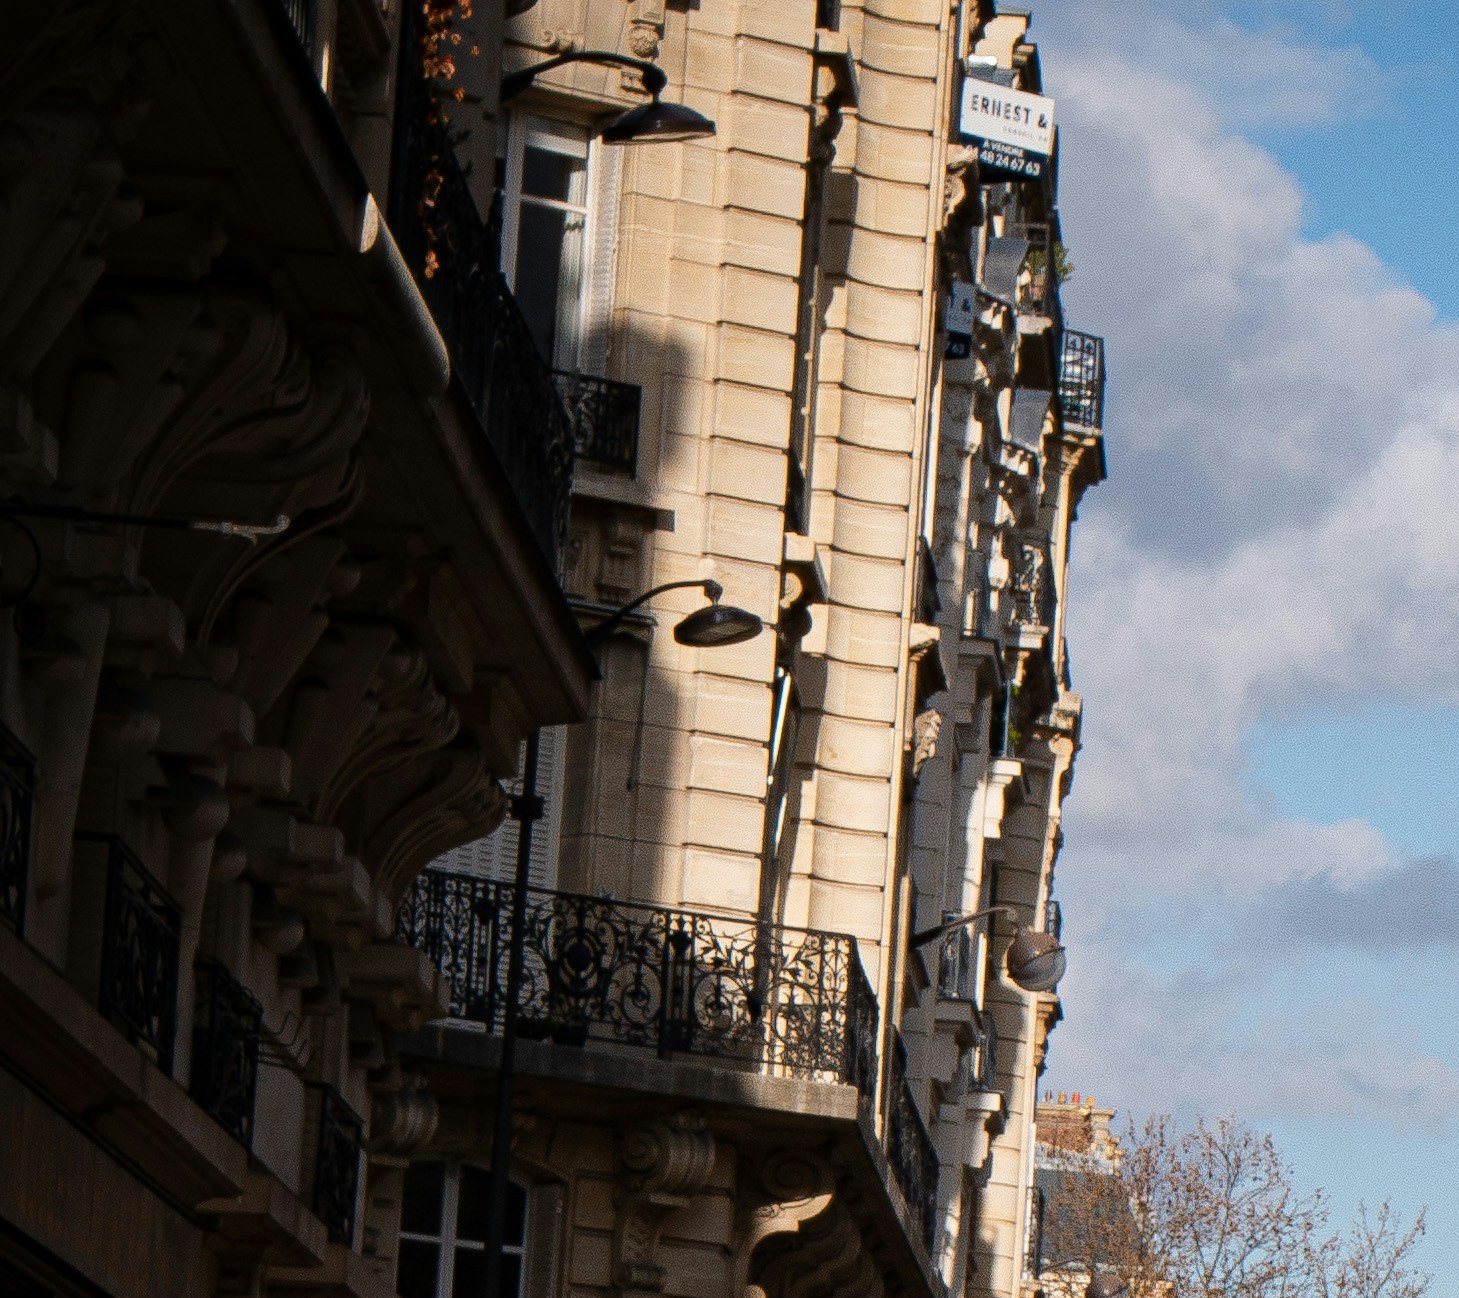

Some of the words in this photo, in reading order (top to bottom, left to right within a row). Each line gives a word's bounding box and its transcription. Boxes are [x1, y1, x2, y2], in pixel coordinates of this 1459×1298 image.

[971, 95, 1031, 125] ERNEST
[1037, 112, 1048, 129] &
[1010, 156, 1025, 172] 67
[1025, 160, 1041, 176] 63
